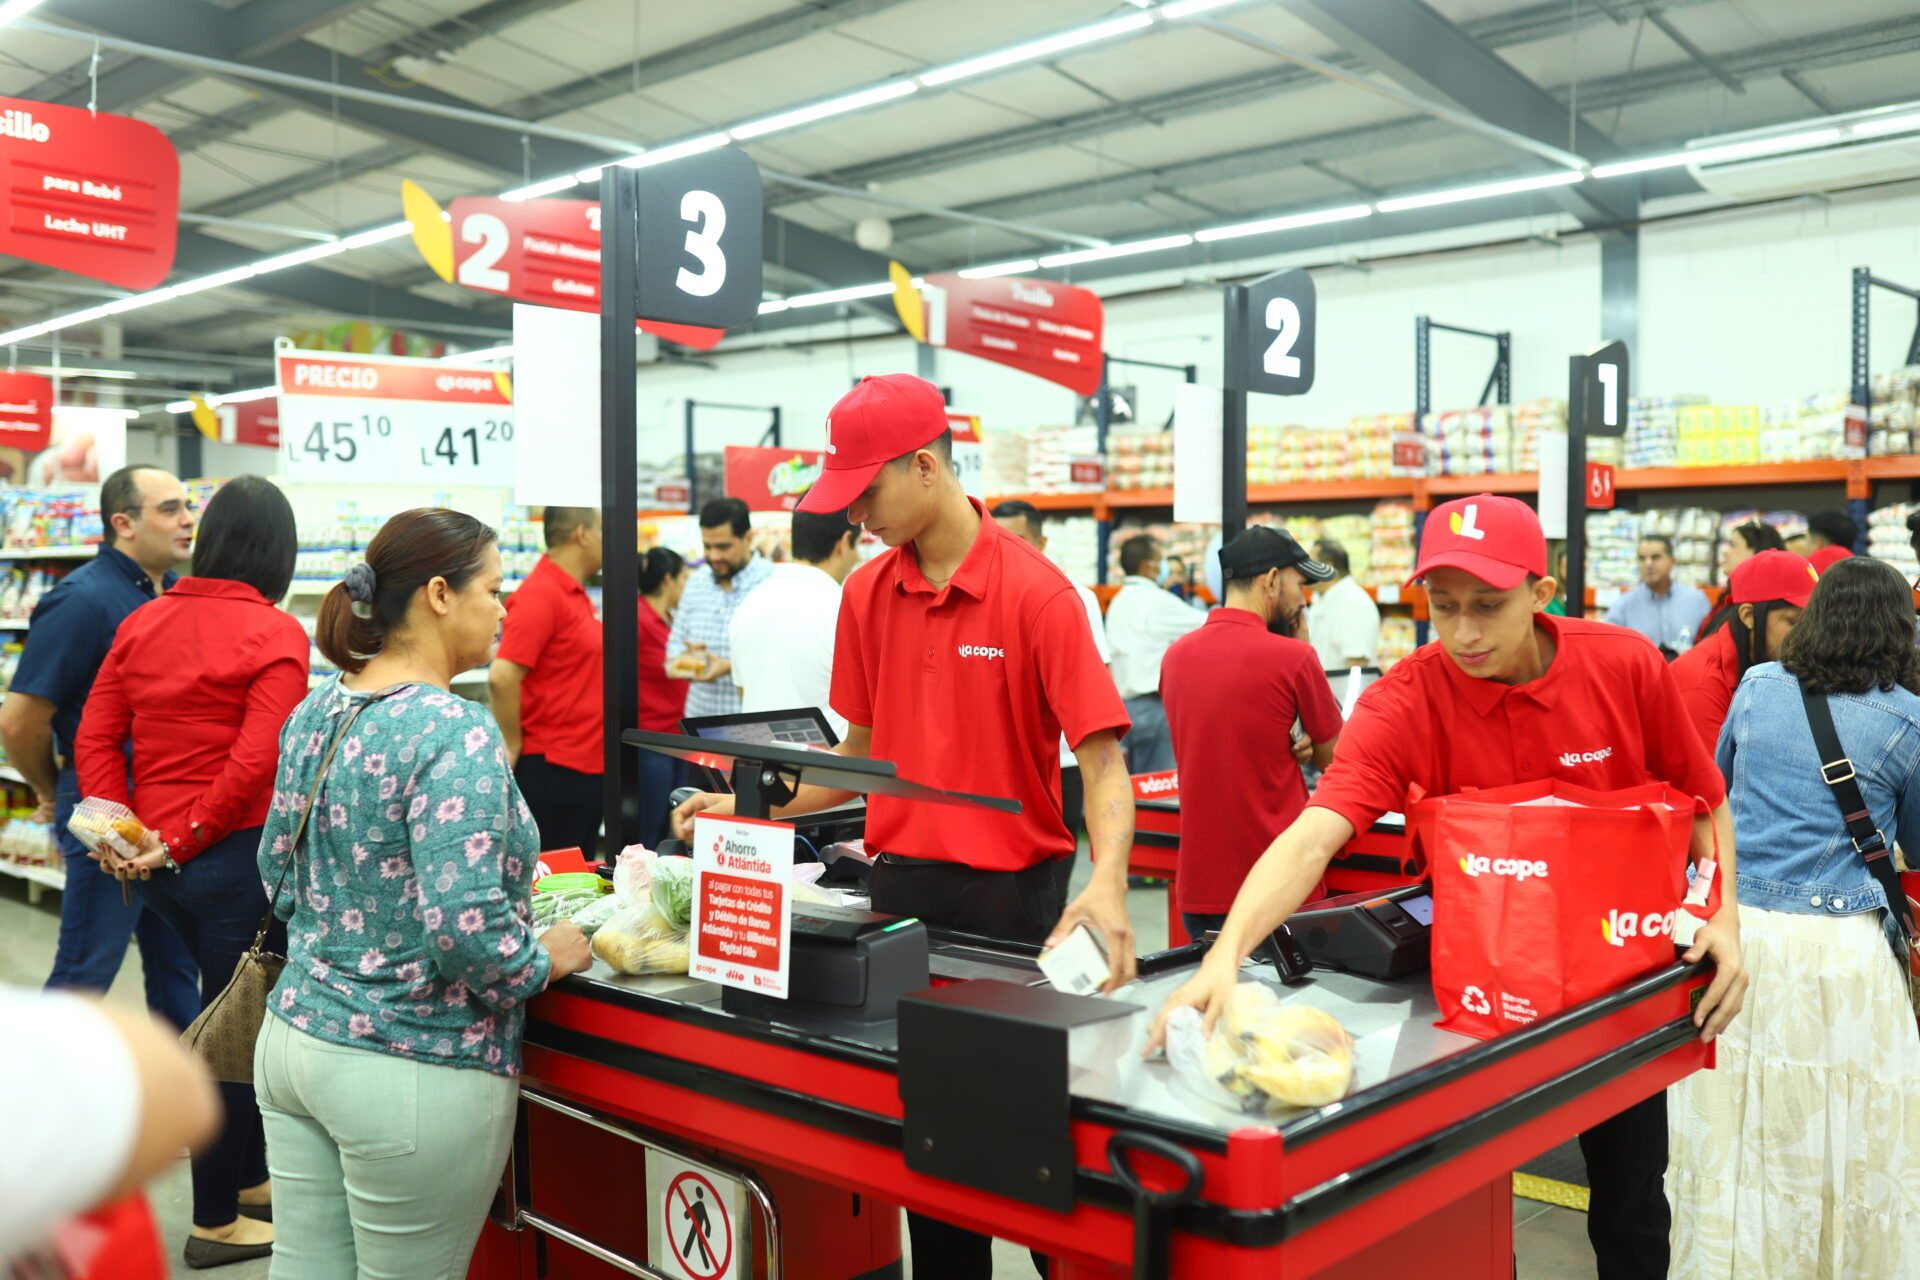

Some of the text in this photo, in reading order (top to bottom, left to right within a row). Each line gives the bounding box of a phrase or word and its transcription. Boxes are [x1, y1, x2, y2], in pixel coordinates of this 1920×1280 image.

[43, 176, 122, 200] para Bebé
[44, 214, 128, 240] Leche UHT
[458, 212, 510, 292] 2
[675, 190, 727, 297] 3
[1263, 297, 1300, 378] 2
[294, 363, 379, 391] PRECIO
[1598, 363, 1618, 426] 1
[1460, 503, 1485, 541] L
[973, 646, 1005, 660] cope
[1582, 746, 1613, 763] cope
[725, 839, 757, 857] Ahorro
[728, 855, 772, 874] Atlántida
[1463, 853, 1548, 881] La cope
[708, 879, 774, 900] al pagar con todas tus
[708, 893, 773, 915] Tarjetas de Crédito
[708, 909, 771, 930] y Débito de Banco
[1608, 908, 1638, 947] La
[701, 922, 734, 938] Atlántida
[746, 931, 777, 947] Billetera
[719, 940, 757, 959] Digital Dilo
